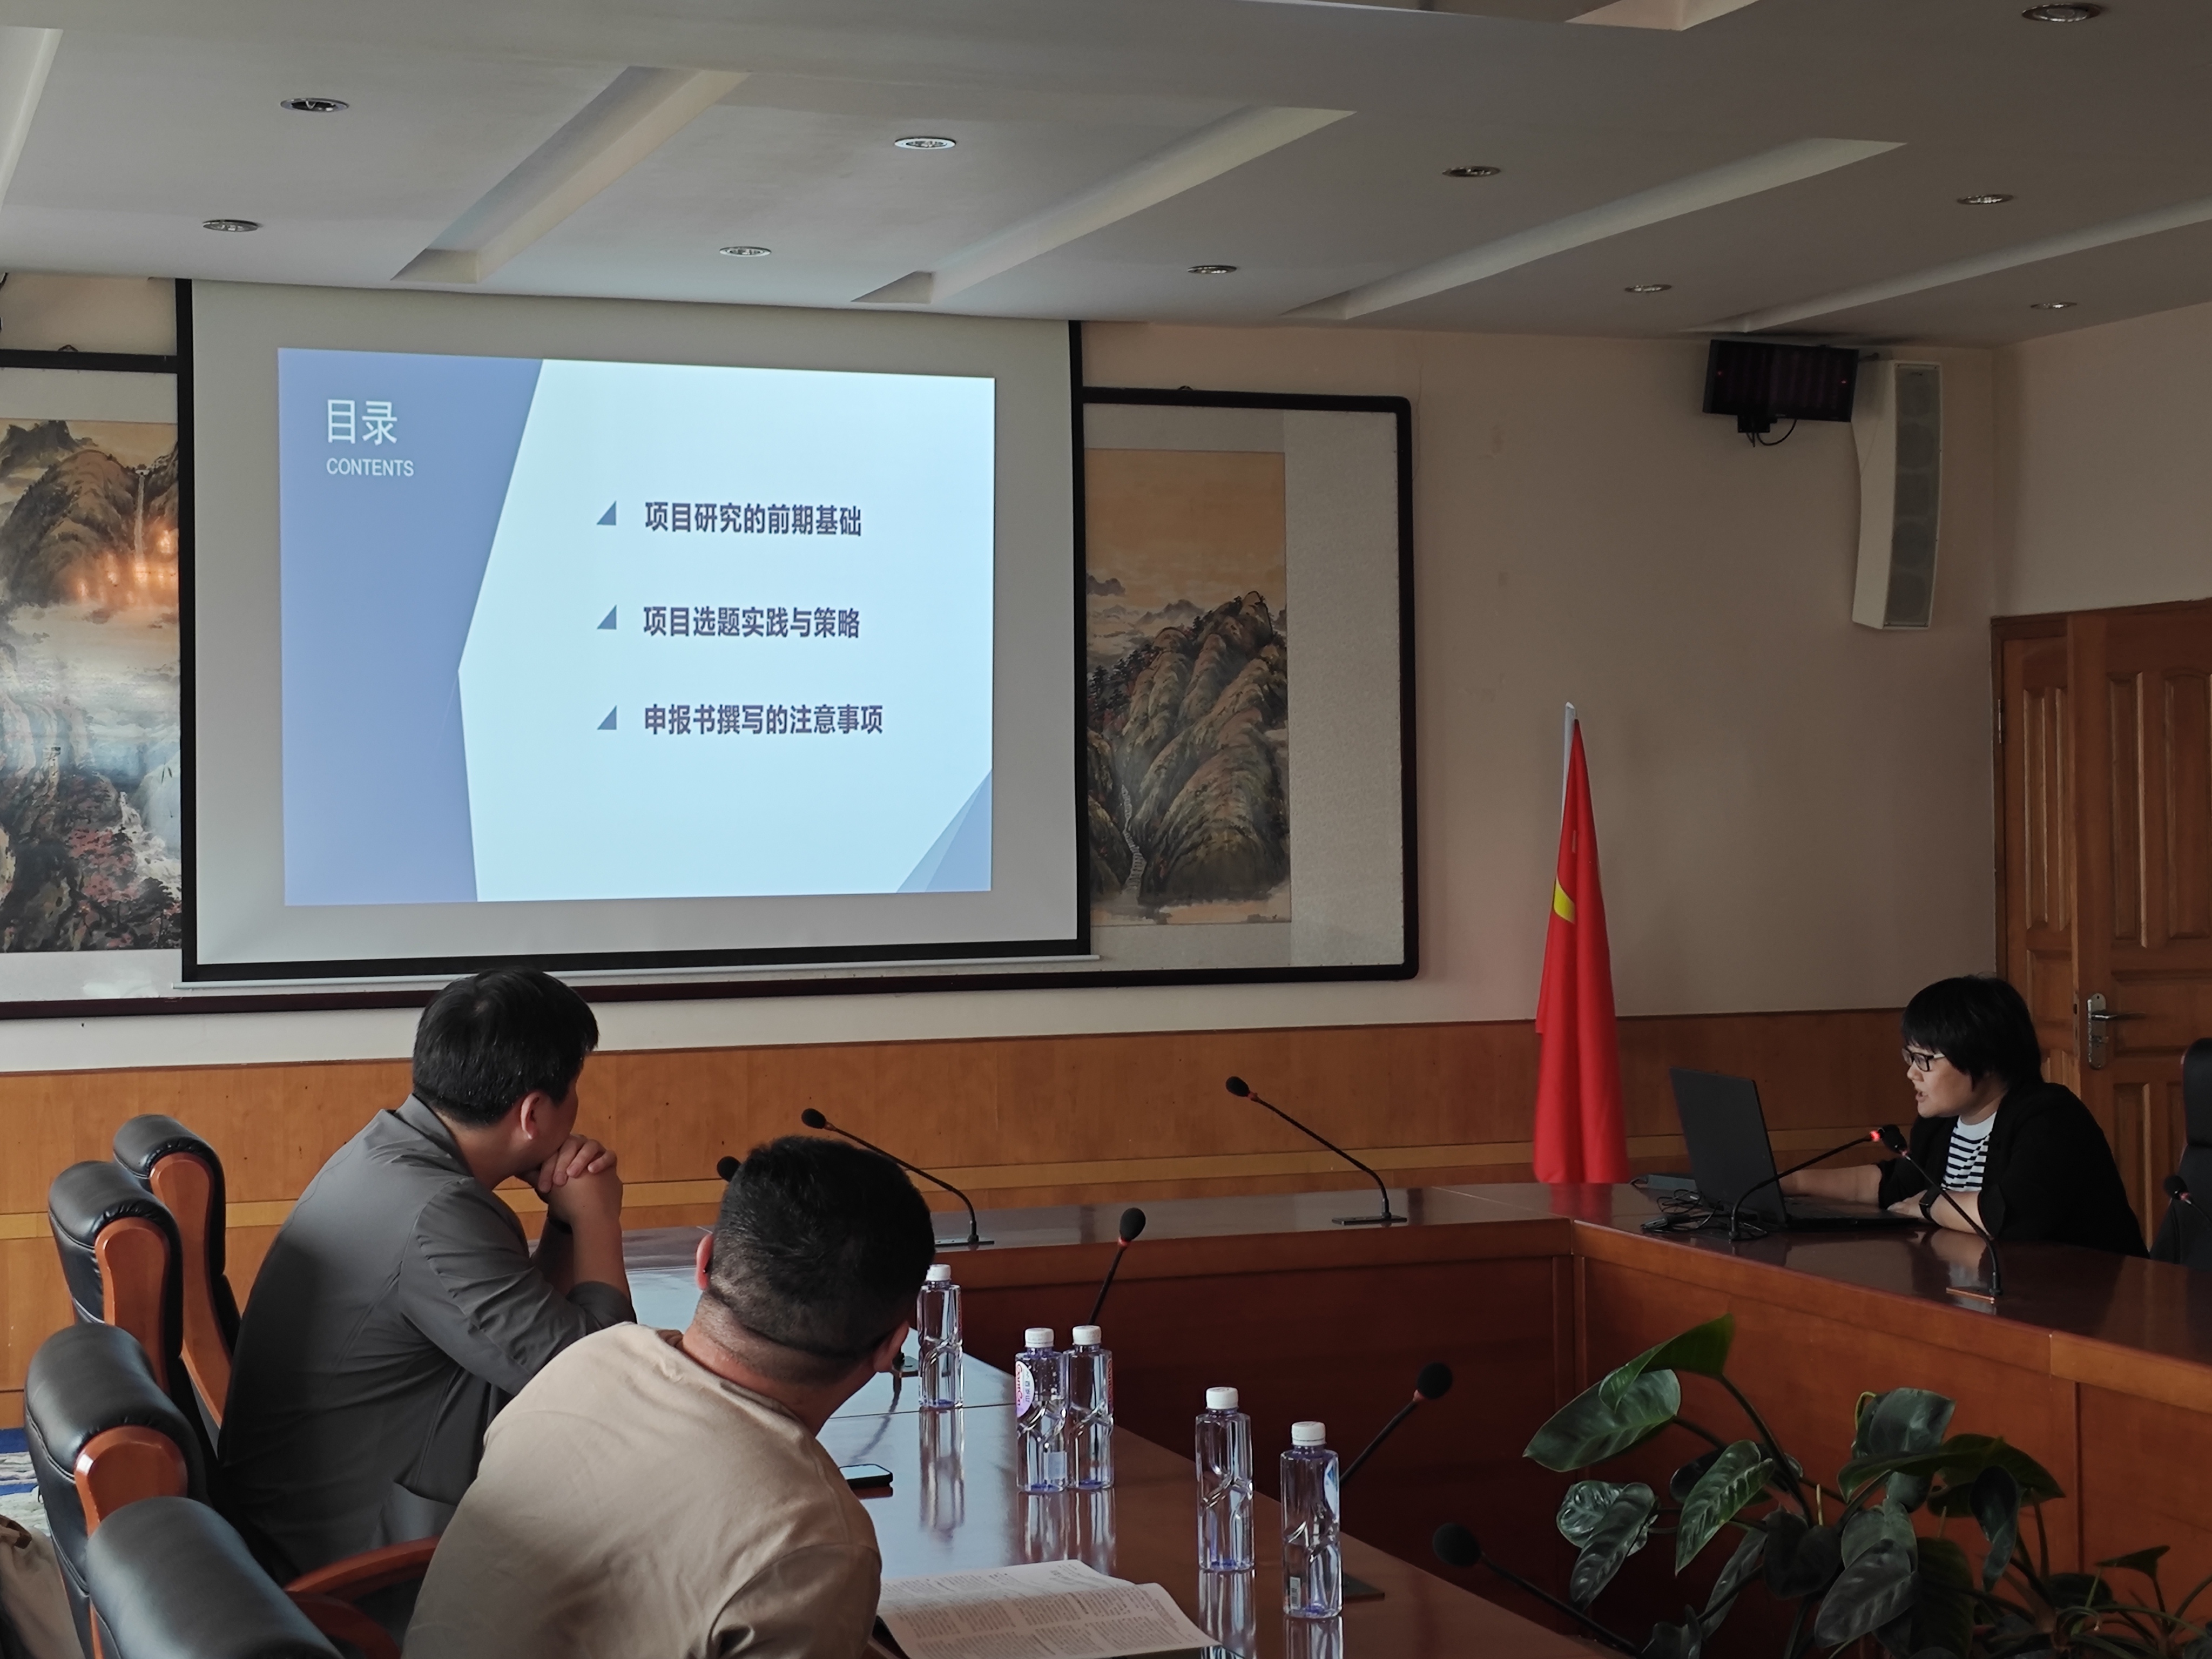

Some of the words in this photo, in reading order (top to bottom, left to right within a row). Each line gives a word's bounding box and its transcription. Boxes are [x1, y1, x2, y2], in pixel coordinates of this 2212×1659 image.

[327, 399, 397, 446] 目录
[327, 457, 414, 477] CONTENTS
[645, 501, 861, 537] 项目研究的前期基础
[644, 606, 860, 638] 项目选题实践与策略
[645, 704, 883, 736] 申报书撰写的注意事项
